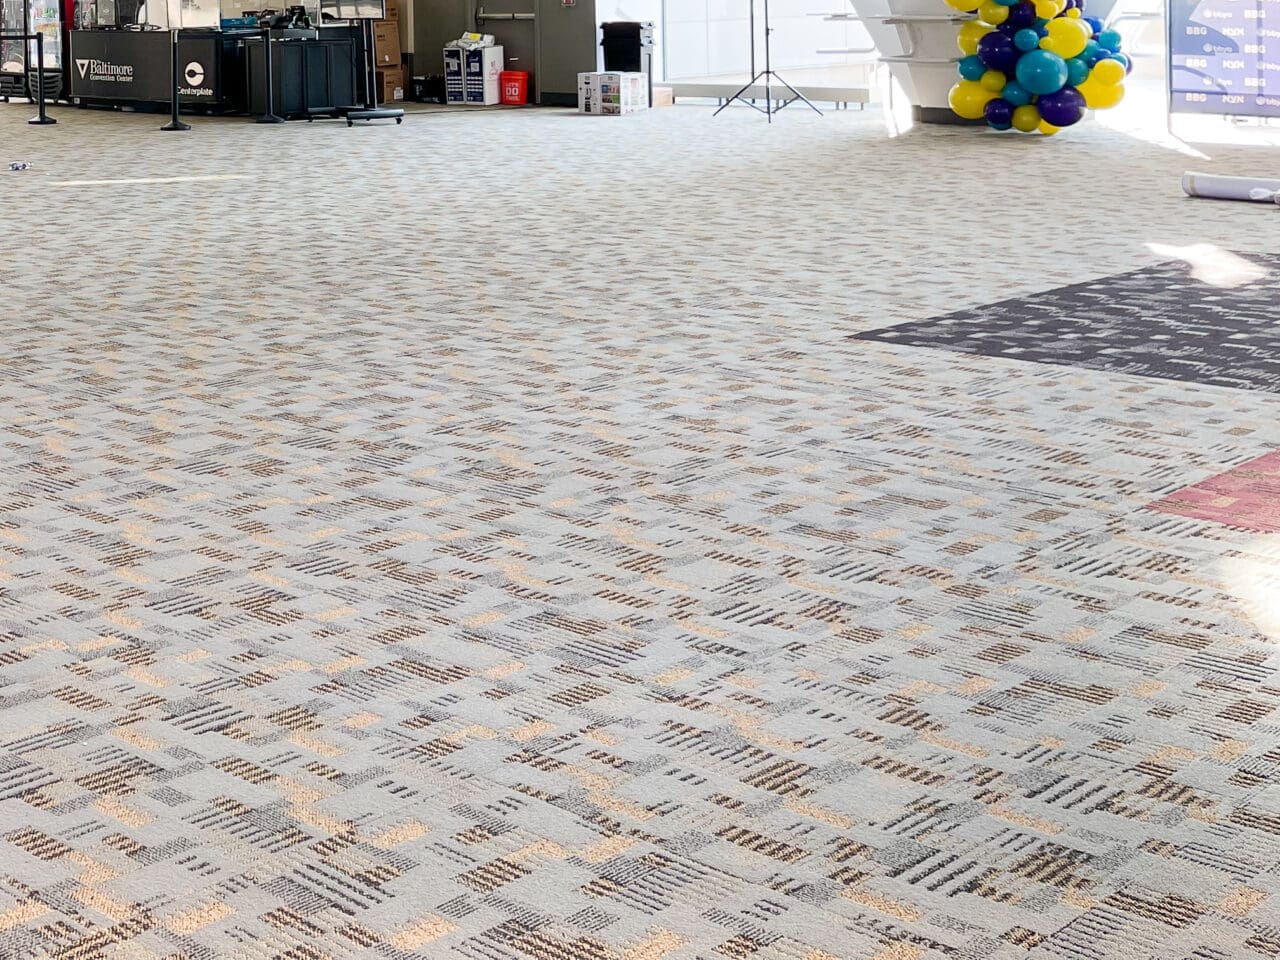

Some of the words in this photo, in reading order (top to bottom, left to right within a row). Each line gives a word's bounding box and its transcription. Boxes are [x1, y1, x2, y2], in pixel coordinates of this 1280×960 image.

[1185, 26, 1207, 36] BBG
[90, 59, 133, 76] Baltimore
[90, 74, 115, 82] Convention
[116, 75, 134, 83] Center
[505, 87, 519, 96] DO
